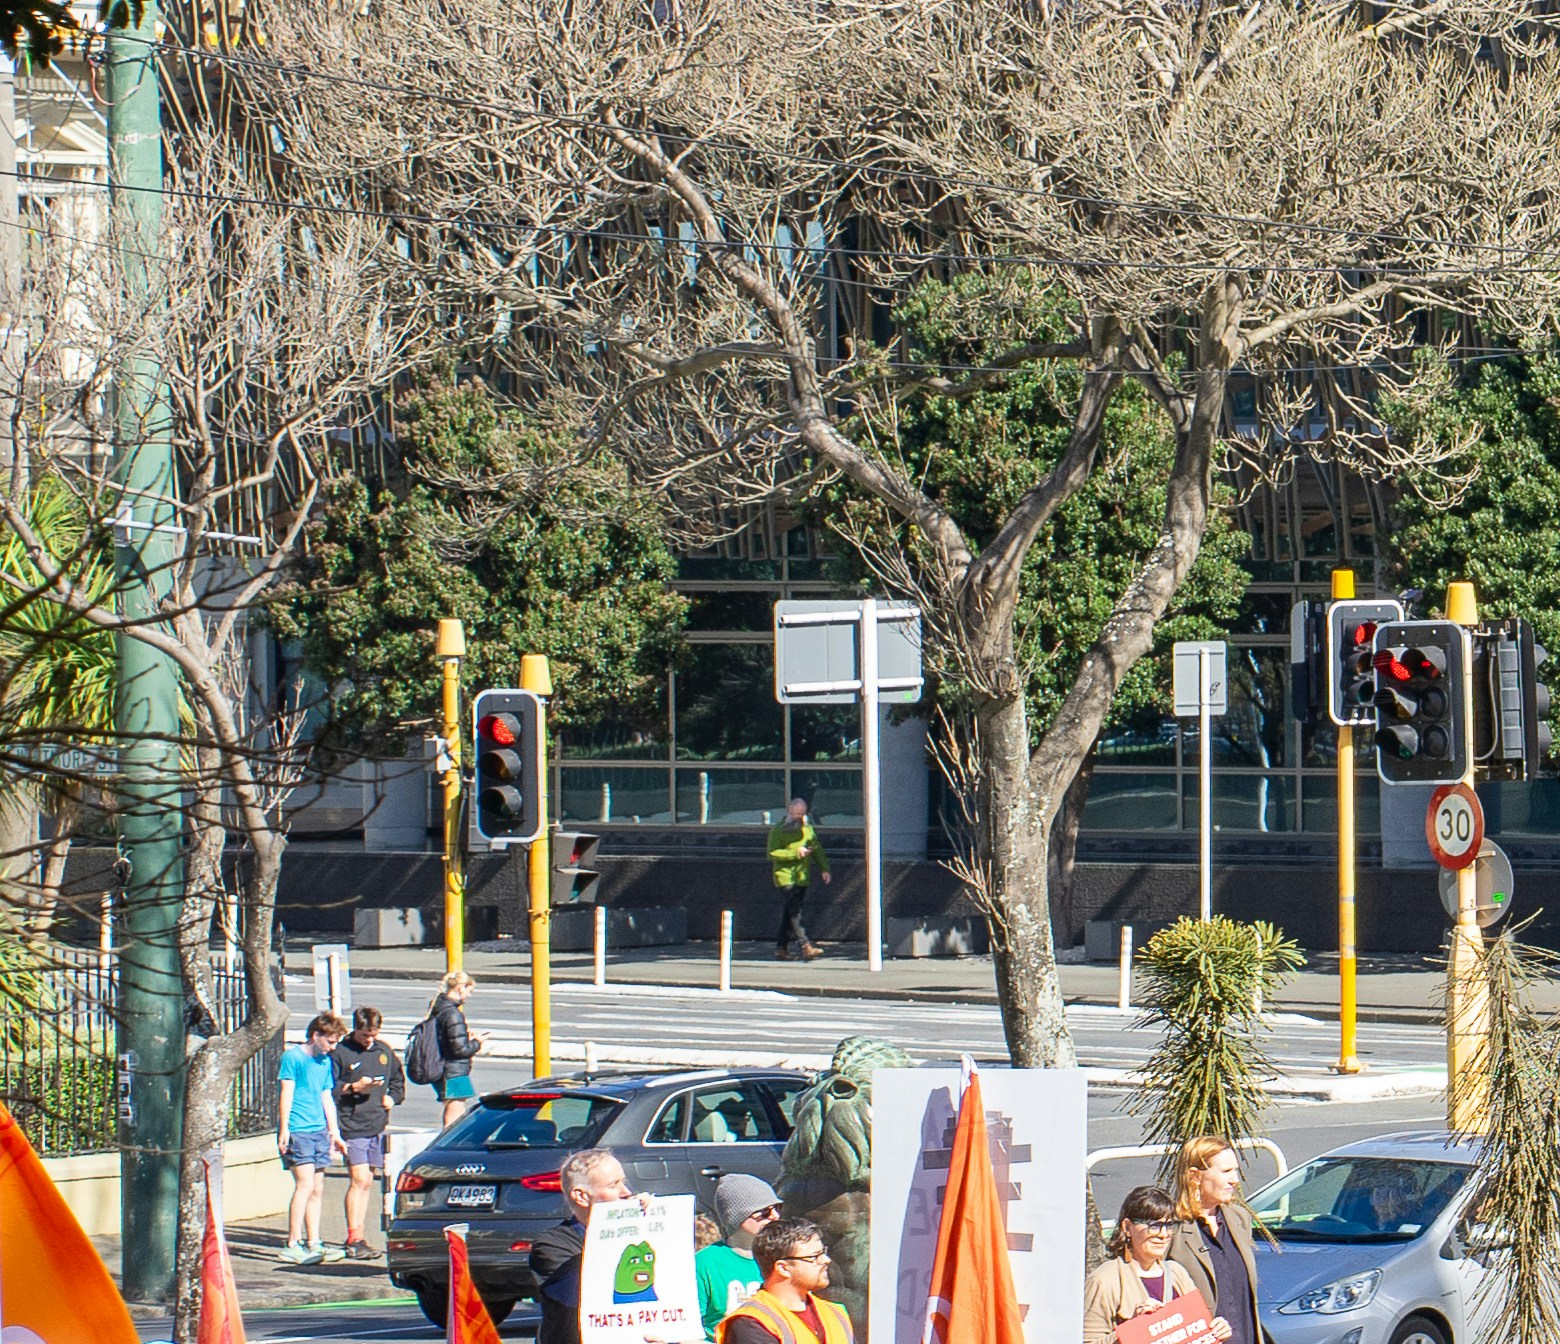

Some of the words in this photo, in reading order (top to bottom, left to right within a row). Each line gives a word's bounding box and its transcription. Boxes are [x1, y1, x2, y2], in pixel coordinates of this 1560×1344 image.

[1440, 808, 1470, 842] 30
[588, 1312, 623, 1328] THAT'S
[626, 1313, 635, 1327] A
[638, 1309, 659, 1324] PAY
[662, 1308, 687, 1322] CUT.
[1148, 1312, 1184, 1337] STAND
[1185, 1318, 1208, 1338] FOR
